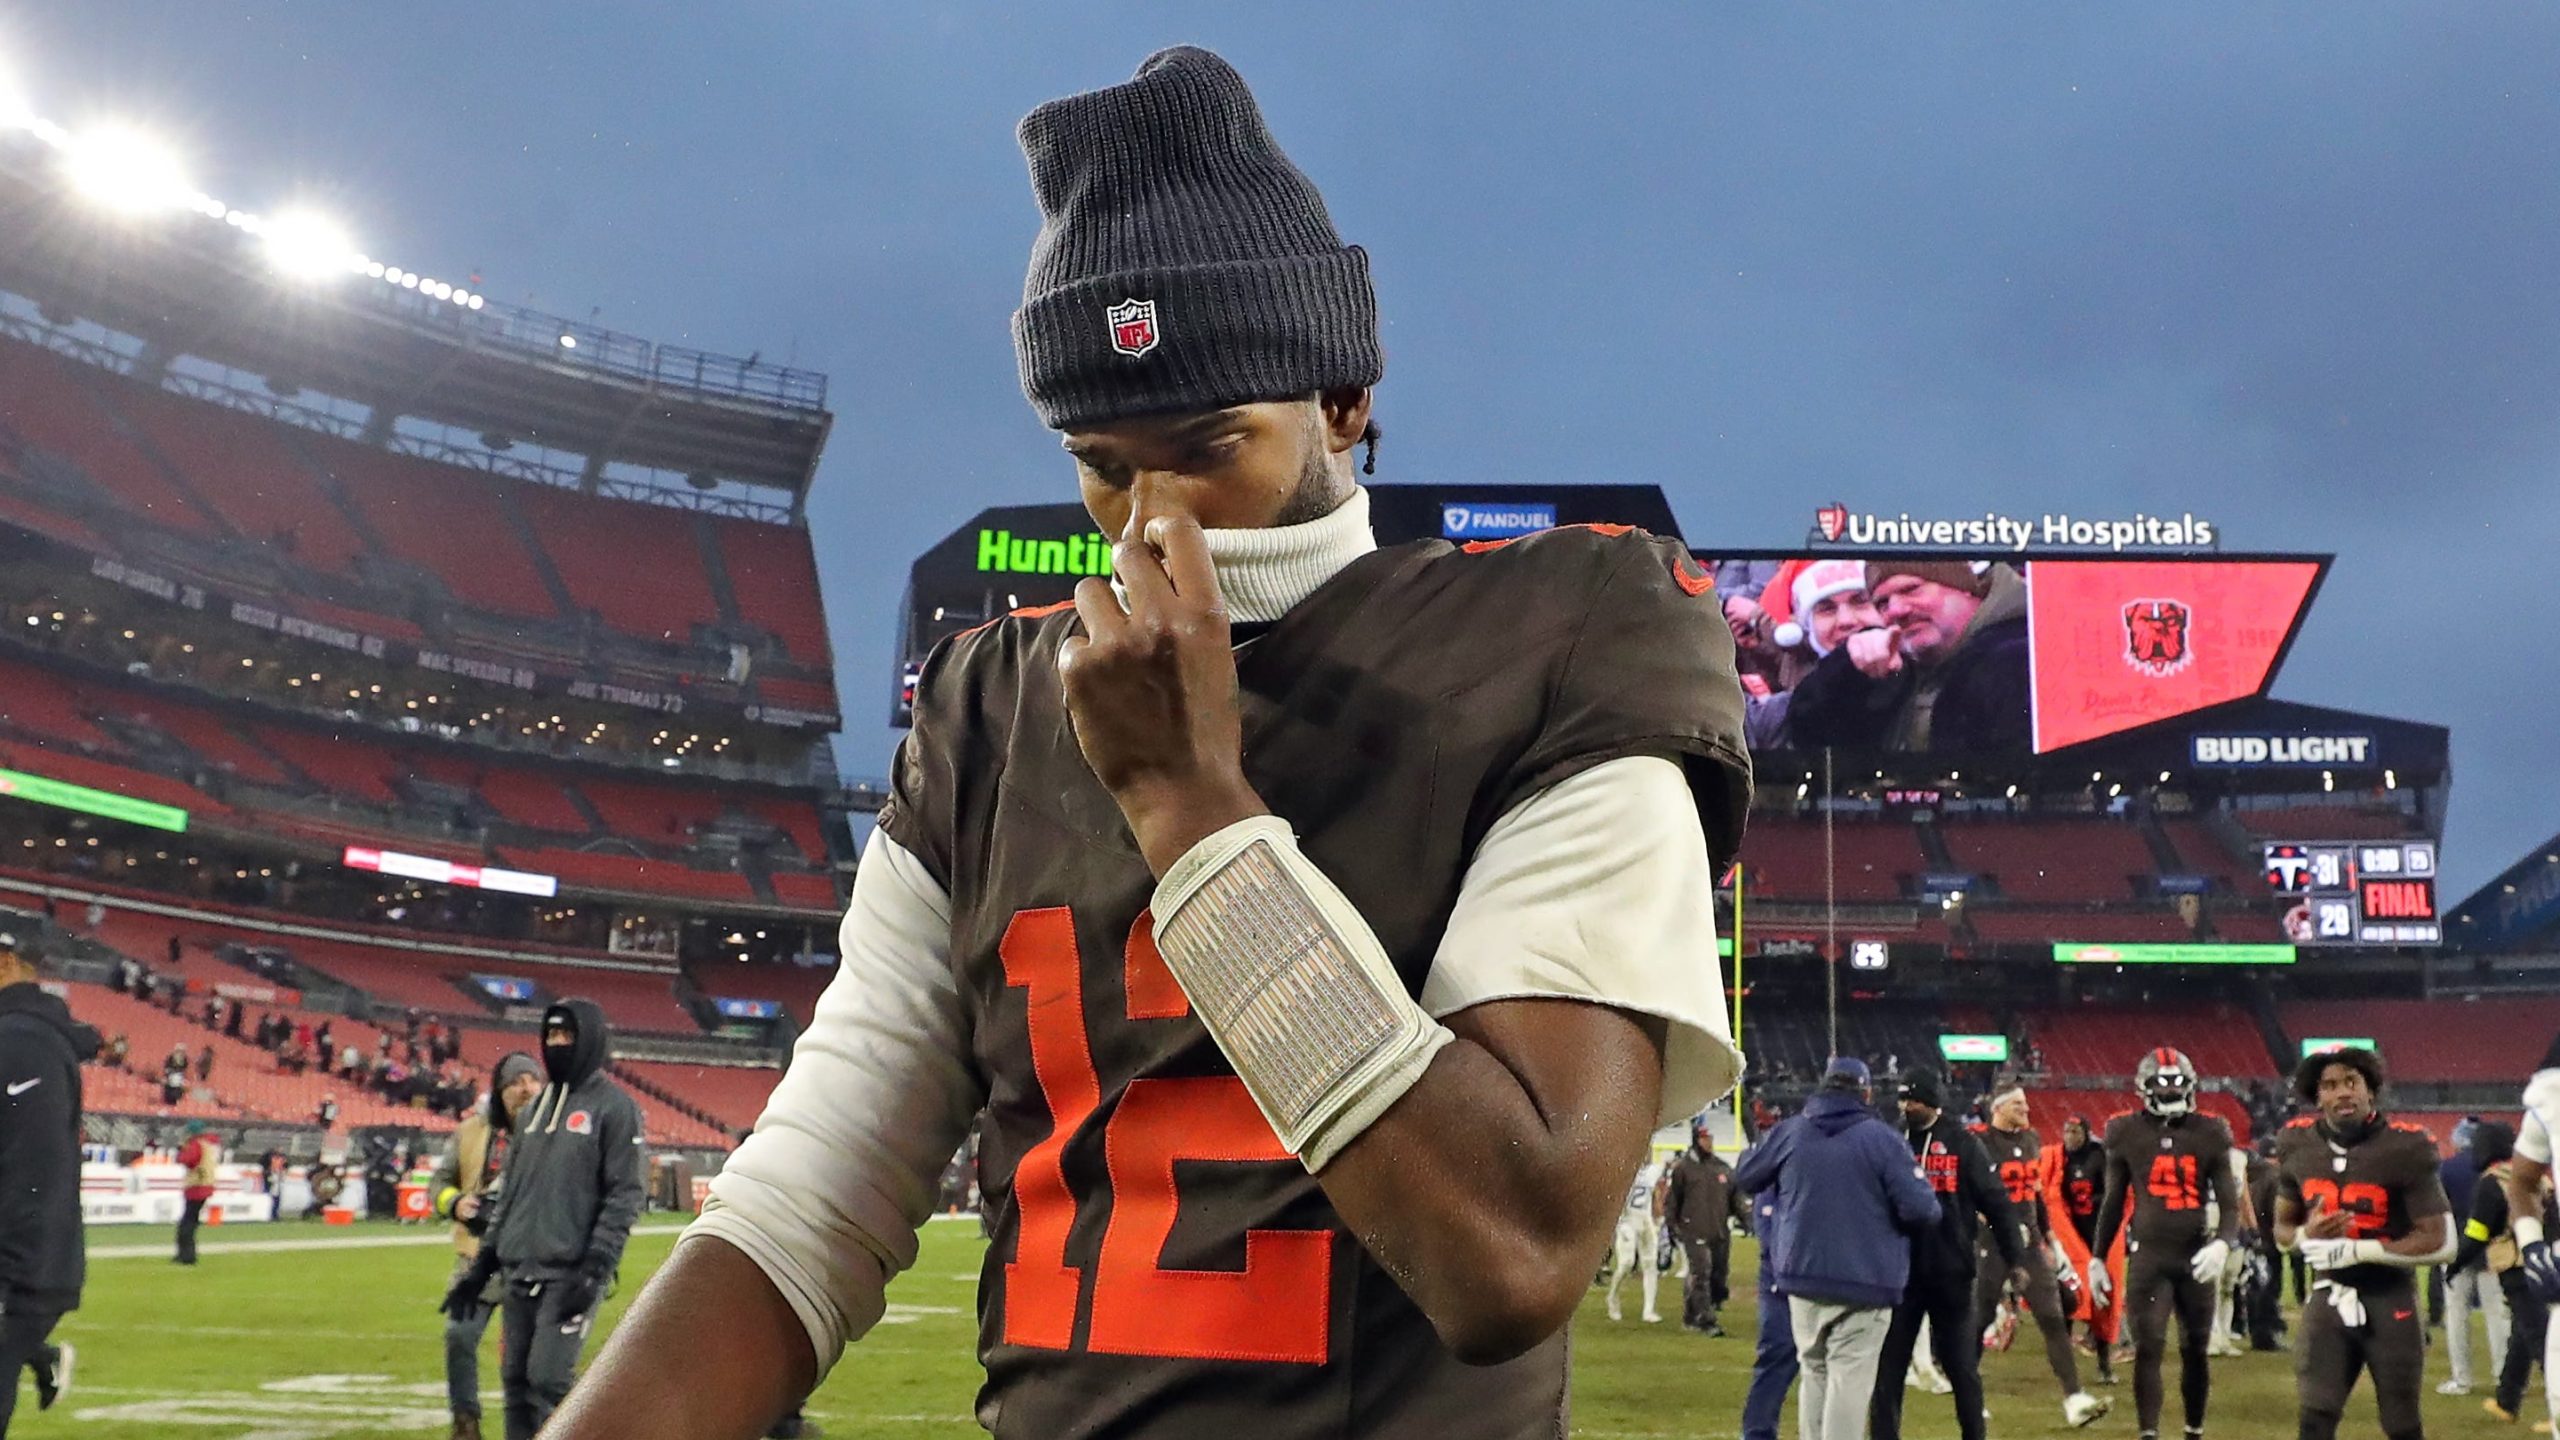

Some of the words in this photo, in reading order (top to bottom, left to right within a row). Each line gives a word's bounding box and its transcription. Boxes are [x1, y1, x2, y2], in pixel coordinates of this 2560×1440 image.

[1472, 513, 1555, 528] FANDUEL
[1849, 512, 2033, 552] University
[2043, 512, 2212, 552] Hospitals
[2196, 737, 2268, 762] BUD
[2270, 737, 2369, 762] LIGHT
[2316, 854, 2340, 886] 31
[2365, 882, 2432, 917] FINAL
[999, 905, 1335, 1365] 12
[2147, 1154, 2200, 1210] 41
